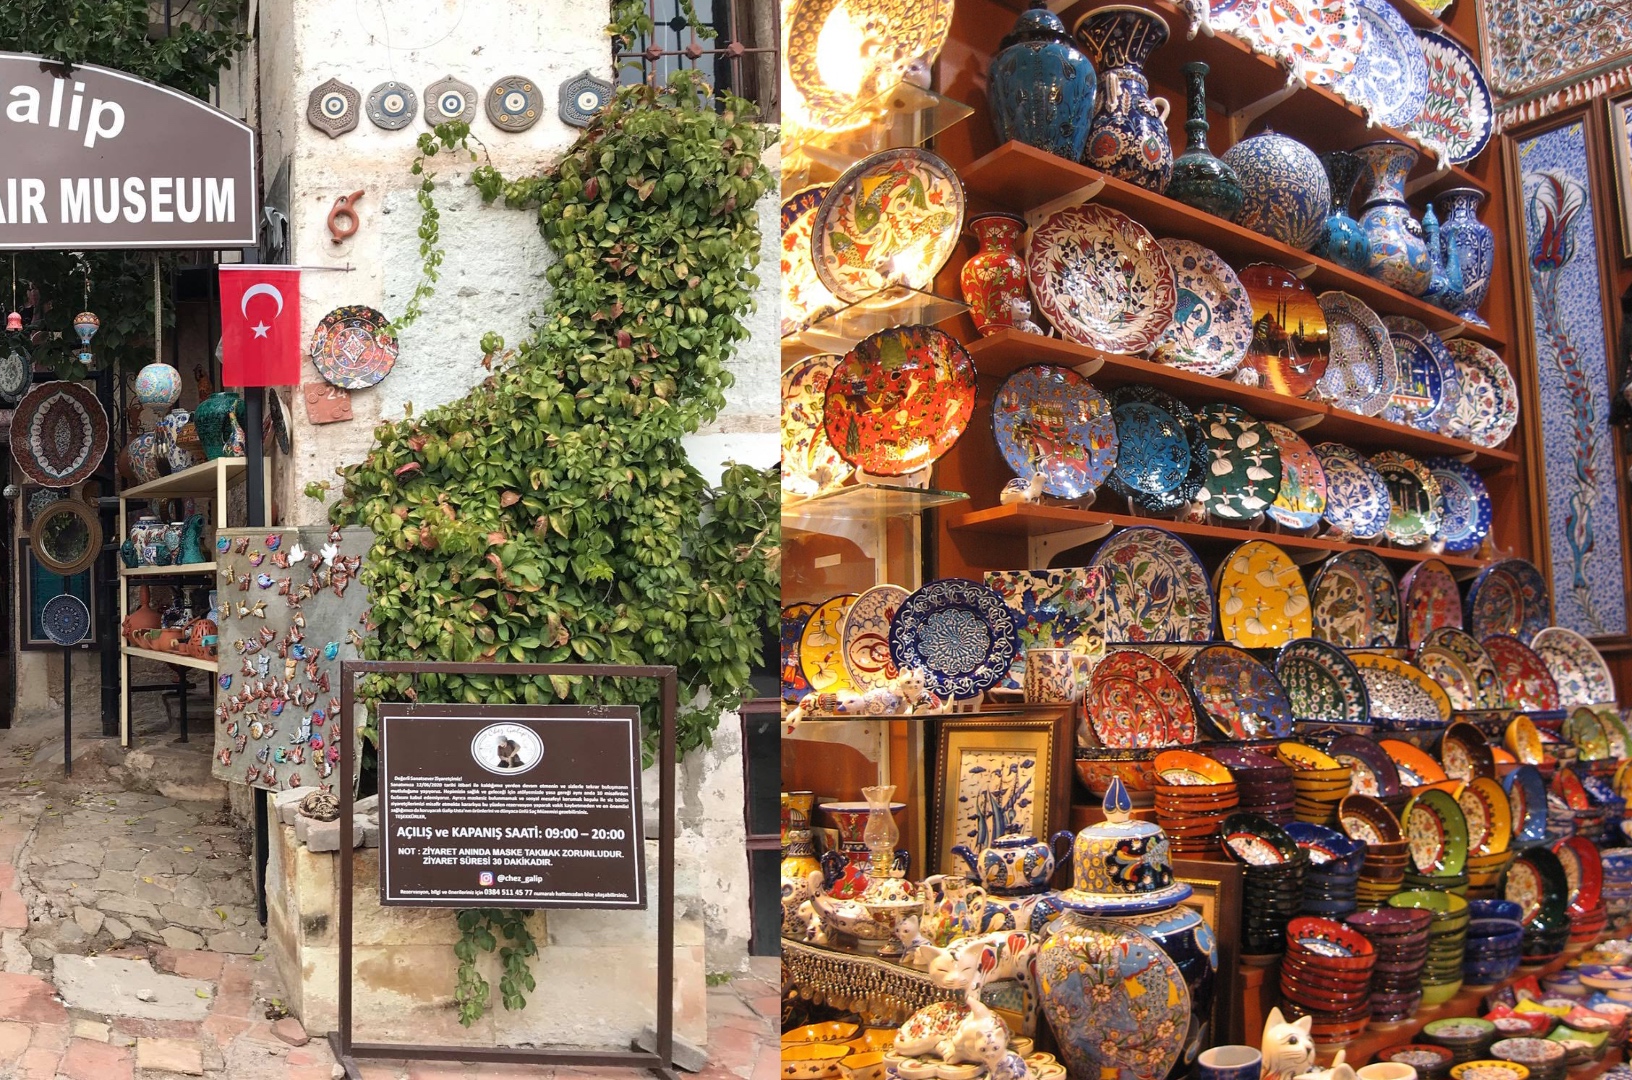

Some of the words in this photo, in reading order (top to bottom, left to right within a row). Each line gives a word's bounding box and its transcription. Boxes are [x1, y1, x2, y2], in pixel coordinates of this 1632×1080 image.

[59, 176, 236, 224] MUSEUM
[395, 826, 433, 840] AÇILIŞ
[434, 828, 449, 837] ve
[451, 826, 503, 840] KAPANIŞ
[504, 825, 542, 839] SAATİ:
[544, 827, 578, 839] 09:00
[590, 828, 625, 840] 20:00
[397, 847, 416, 855] NOT
[421, 846, 457, 856] ZİYARET
[457, 848, 491, 856] ANINDA
[492, 848, 523, 857] MASKE
[525, 848, 560, 857] TAKMAK
[561, 849, 624, 858] ZORUNLUDUR.
[422, 855, 458, 865] ZİYARET
[459, 855, 491, 865] SÜRESİ
[491, 857, 502, 865] 30
[503, 855, 553, 866] DAKİKADIR.
[496, 874, 543, 884] @chez_galip
